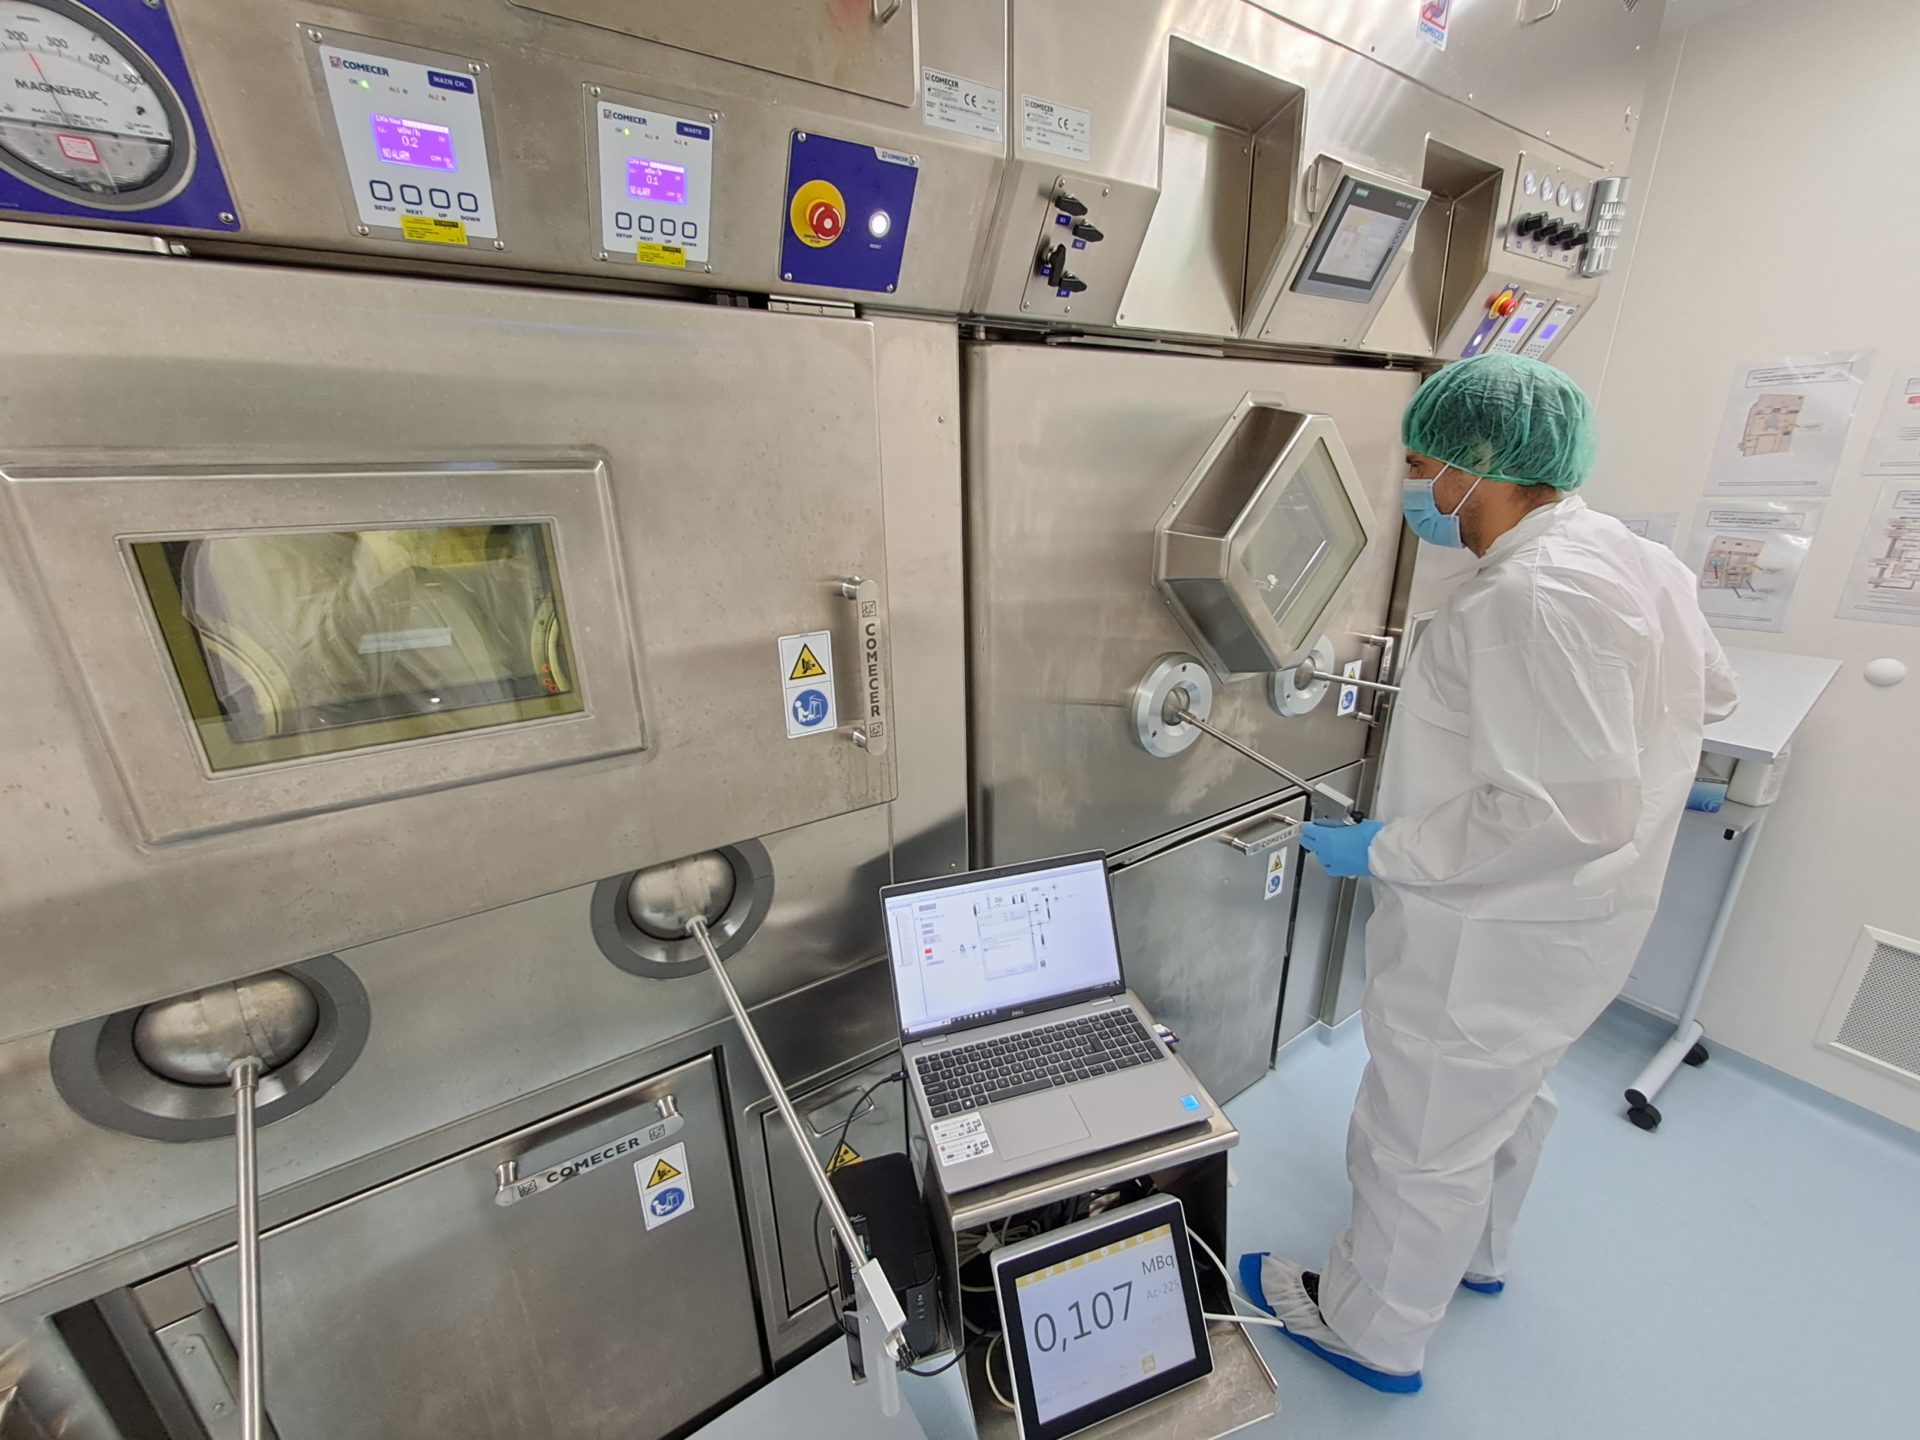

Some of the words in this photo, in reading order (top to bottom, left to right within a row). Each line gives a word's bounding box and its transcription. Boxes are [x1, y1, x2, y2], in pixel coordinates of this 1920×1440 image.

[5, 29, 28, 42] 200
[45, 35, 68, 49] 300
[89, 52, 110, 65] 400
[343, 60, 389, 76] COMECER
[123, 74, 144, 85] 500
[433, 75, 453, 87] MAIN
[931, 74, 959, 88] COMECER
[15, 78, 102, 101] MAGNEHELIC
[613, 112, 647, 125] COMECER
[865, 622, 881, 717] COMECER
[546, 1137, 640, 1183] COMECER
[1141, 1253, 1176, 1275] MBq
[1146, 1279, 1180, 1300] Ac-225
[1034, 1280, 1133, 1352] 0,107
